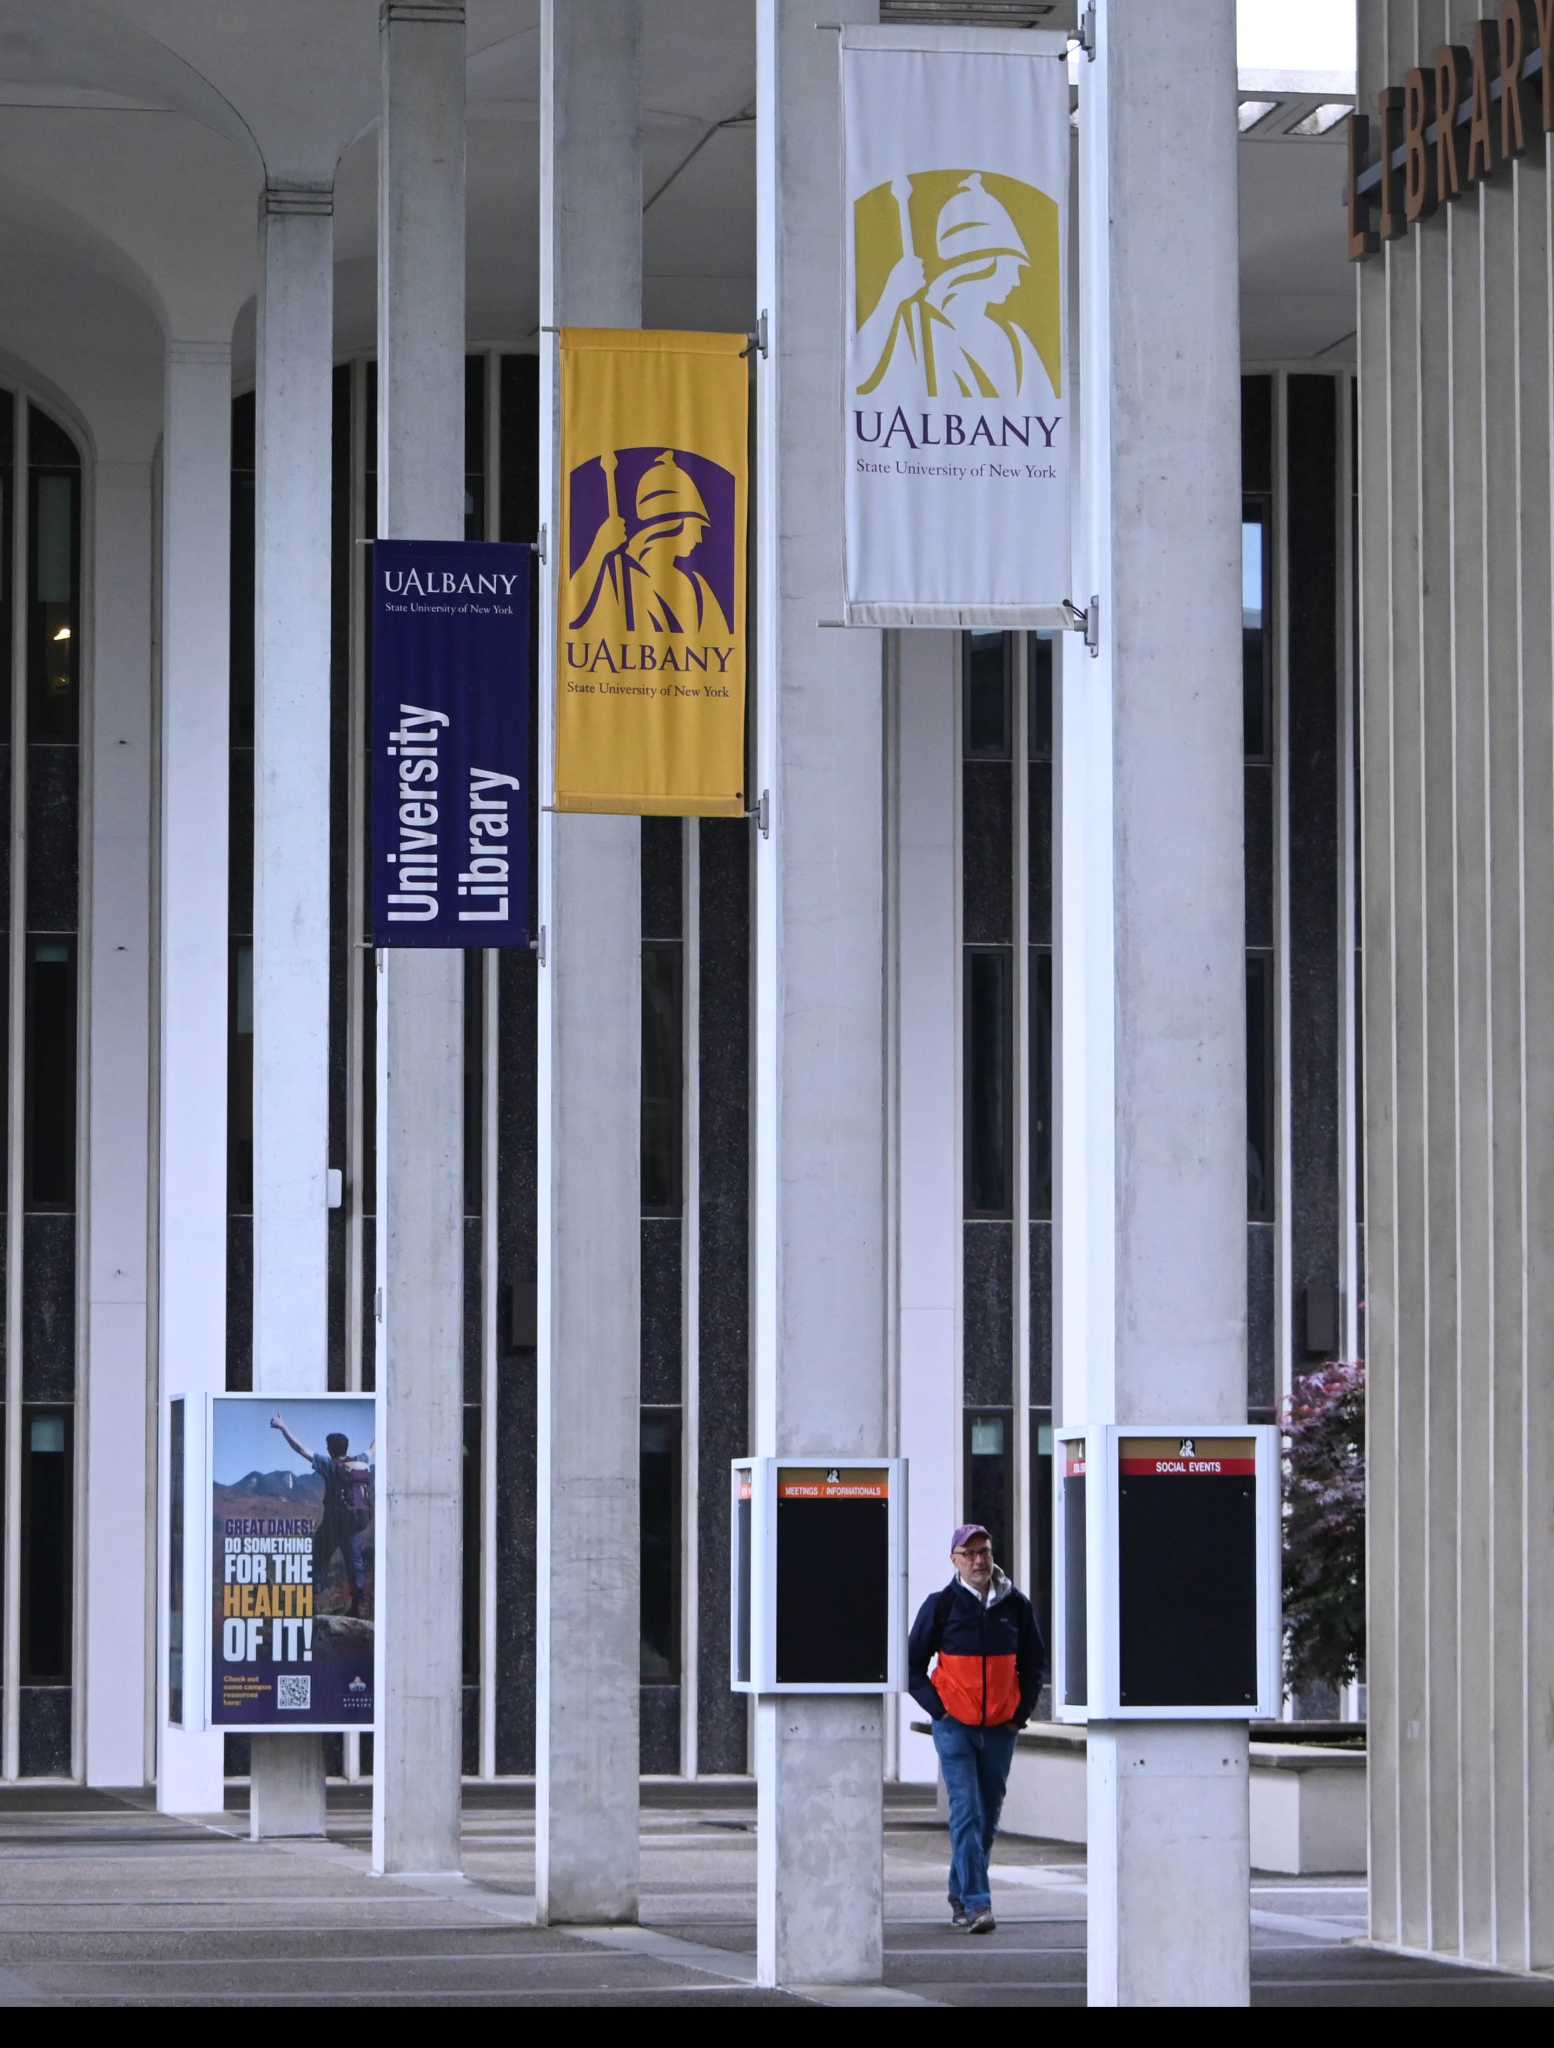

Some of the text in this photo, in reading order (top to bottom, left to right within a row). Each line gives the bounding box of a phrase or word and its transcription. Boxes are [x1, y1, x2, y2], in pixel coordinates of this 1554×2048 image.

[1348, 0, 1554, 262] LIBRARY
[853, 405, 1064, 449] UALBANY
[856, 458, 1056, 480] State University of New York
[384, 568, 518, 596] UALBANY
[385, 602, 513, 616] State University of New York
[566, 638, 735, 674] UALBANY
[567, 682, 730, 699] State University of New York
[387, 704, 450, 921] University
[458, 767, 520, 921] Library
[1156, 1461, 1221, 1473] SOCIAL EVENTS
[785, 1487, 818, 1496] MEETINGS
[826, 1487, 881, 1496] INFORMATIONALS
[225, 1519, 313, 1536] GREAT DANES!
[224, 1537, 313, 1553] DO SOMETHING
[224, 1554, 313, 1584] FOR THE
[223, 1584, 313, 1617] HEALTH
[223, 1618, 313, 1662] OF IT!
